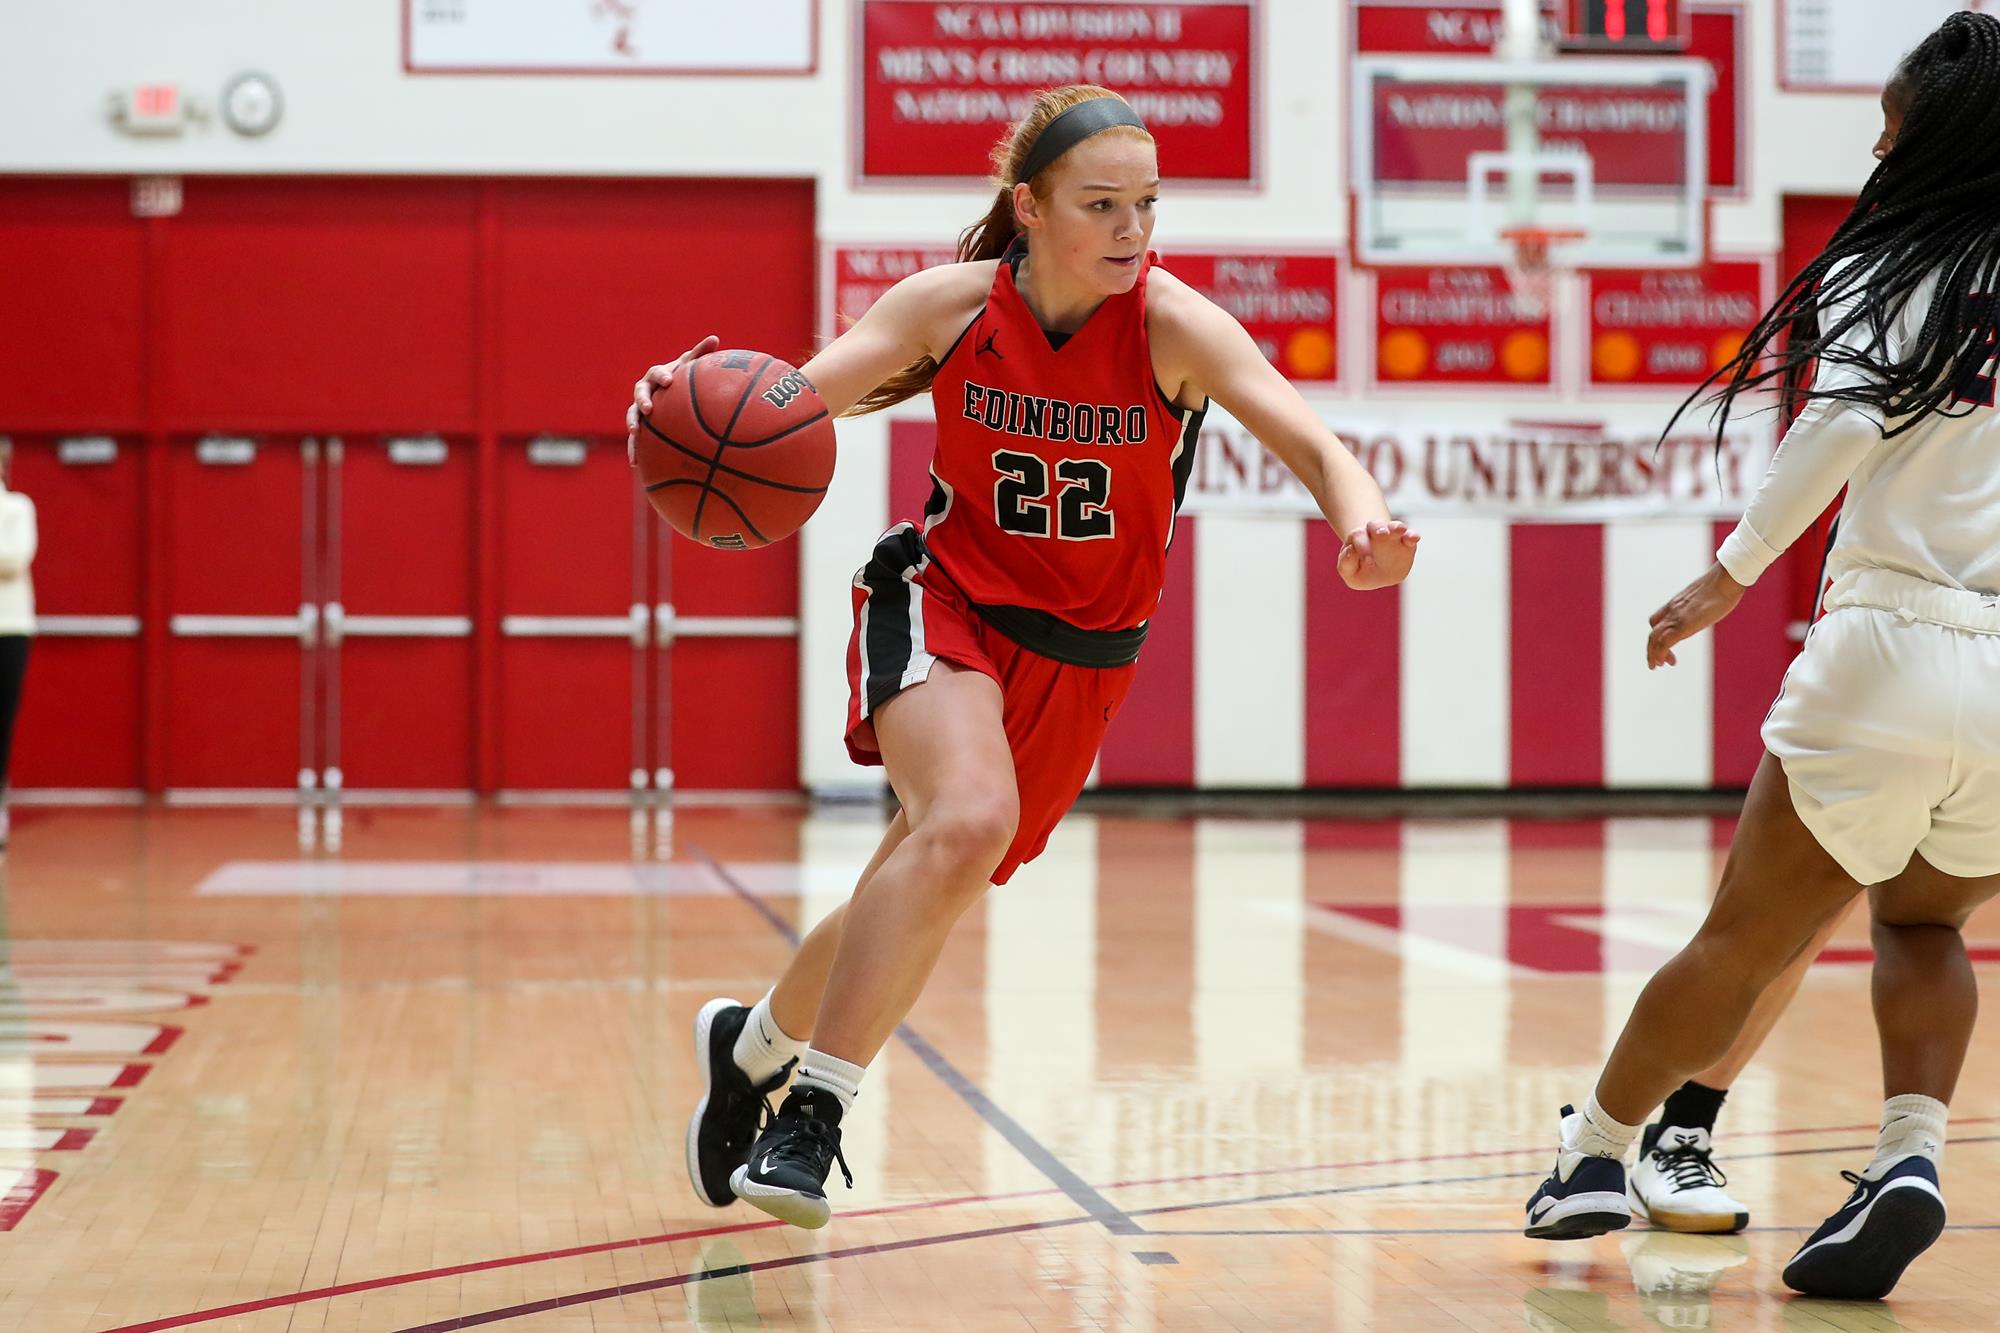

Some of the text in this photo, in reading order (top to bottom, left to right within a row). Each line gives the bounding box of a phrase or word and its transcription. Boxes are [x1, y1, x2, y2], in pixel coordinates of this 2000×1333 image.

[933, 7, 1017, 39] NCAA
[1021, 8, 1152, 40] DIVISION
[879, 49, 1233, 86] MEN'S CROSS COUNTRY
[894, 89, 1032, 122] NATIONA
[1389, 95, 1690, 131] NATION CHAMPION
[1596, 291, 1754, 326] CHAMPIONS
[963, 380, 1147, 445] EDINBORO
[1424, 432, 1753, 500] UNIVERSITY
[992, 448, 1115, 541] 22
